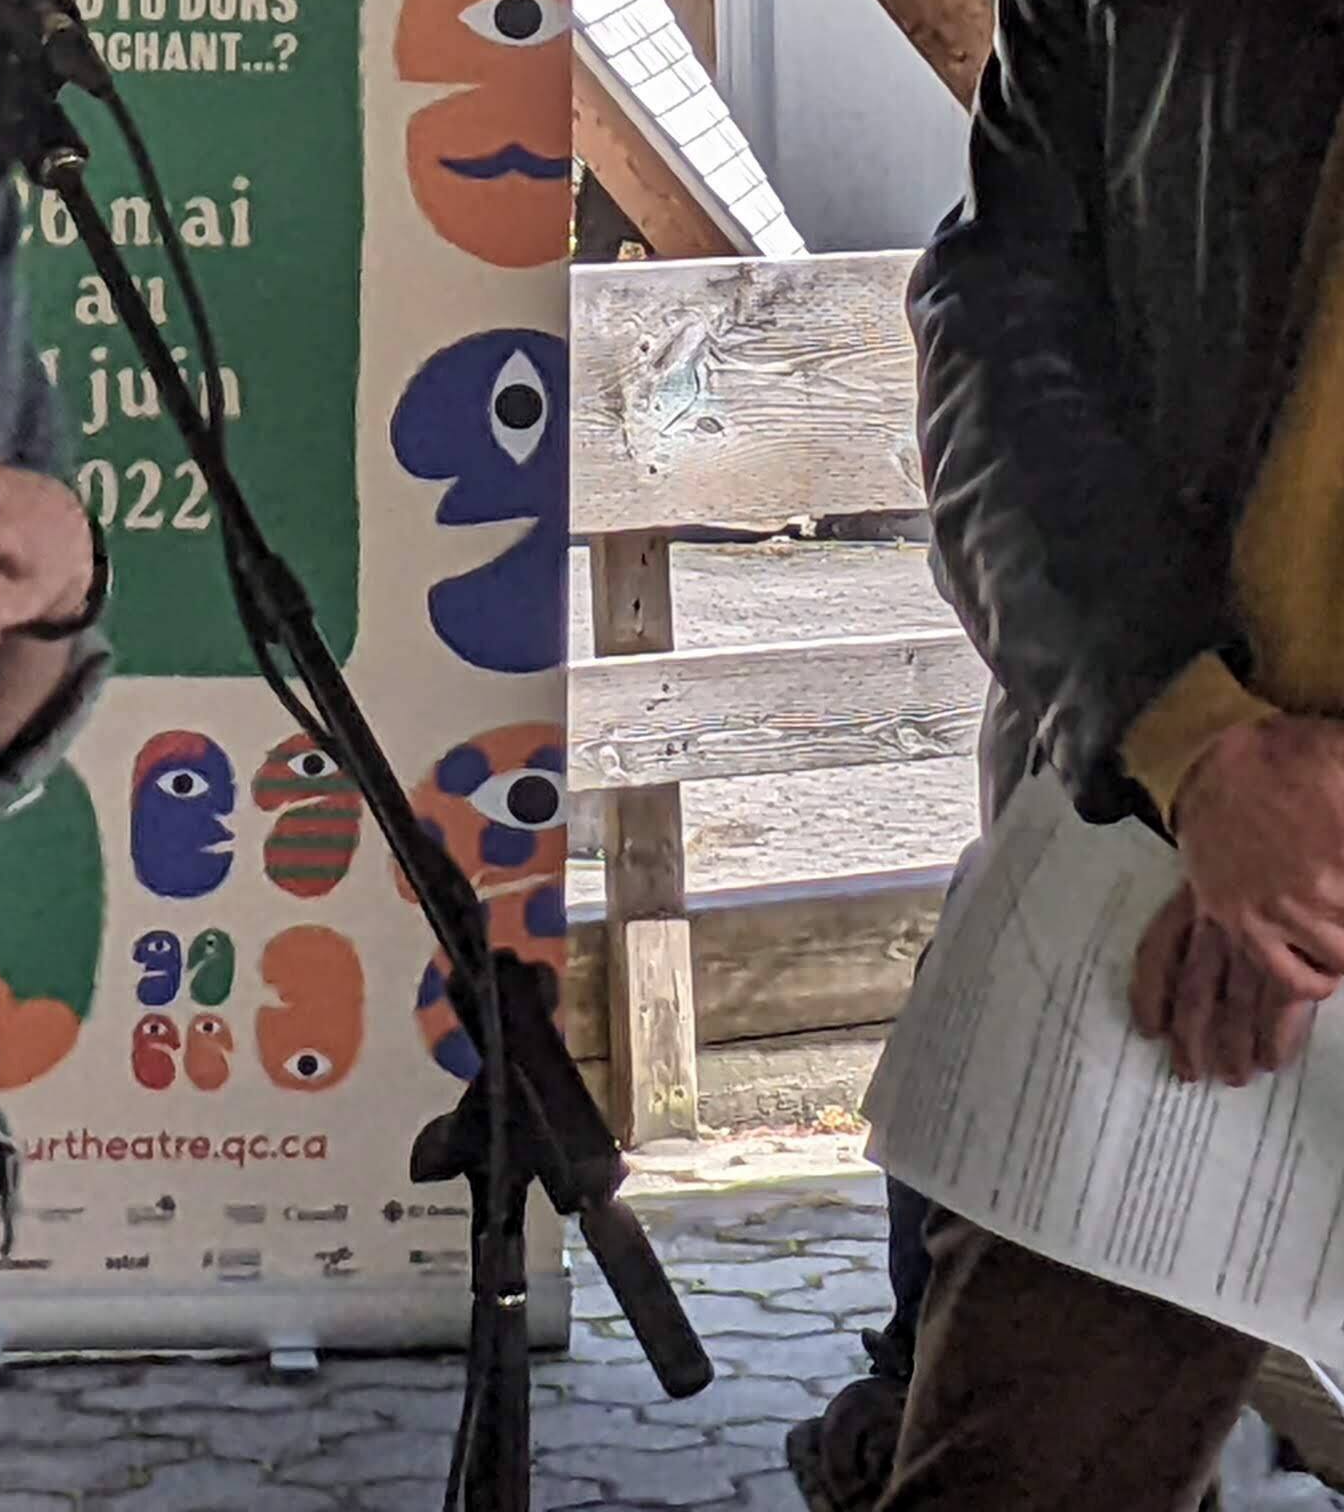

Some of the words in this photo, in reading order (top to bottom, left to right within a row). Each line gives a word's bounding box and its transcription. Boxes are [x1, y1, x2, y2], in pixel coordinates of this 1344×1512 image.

[88, 31, 299, 72] CHANT...?
[110, 174, 251, 248] mai
[74, 275, 168, 326] au
[77, 459, 212, 532] 022
[22, 1128, 328, 1168] urtheatre.qc.ca
